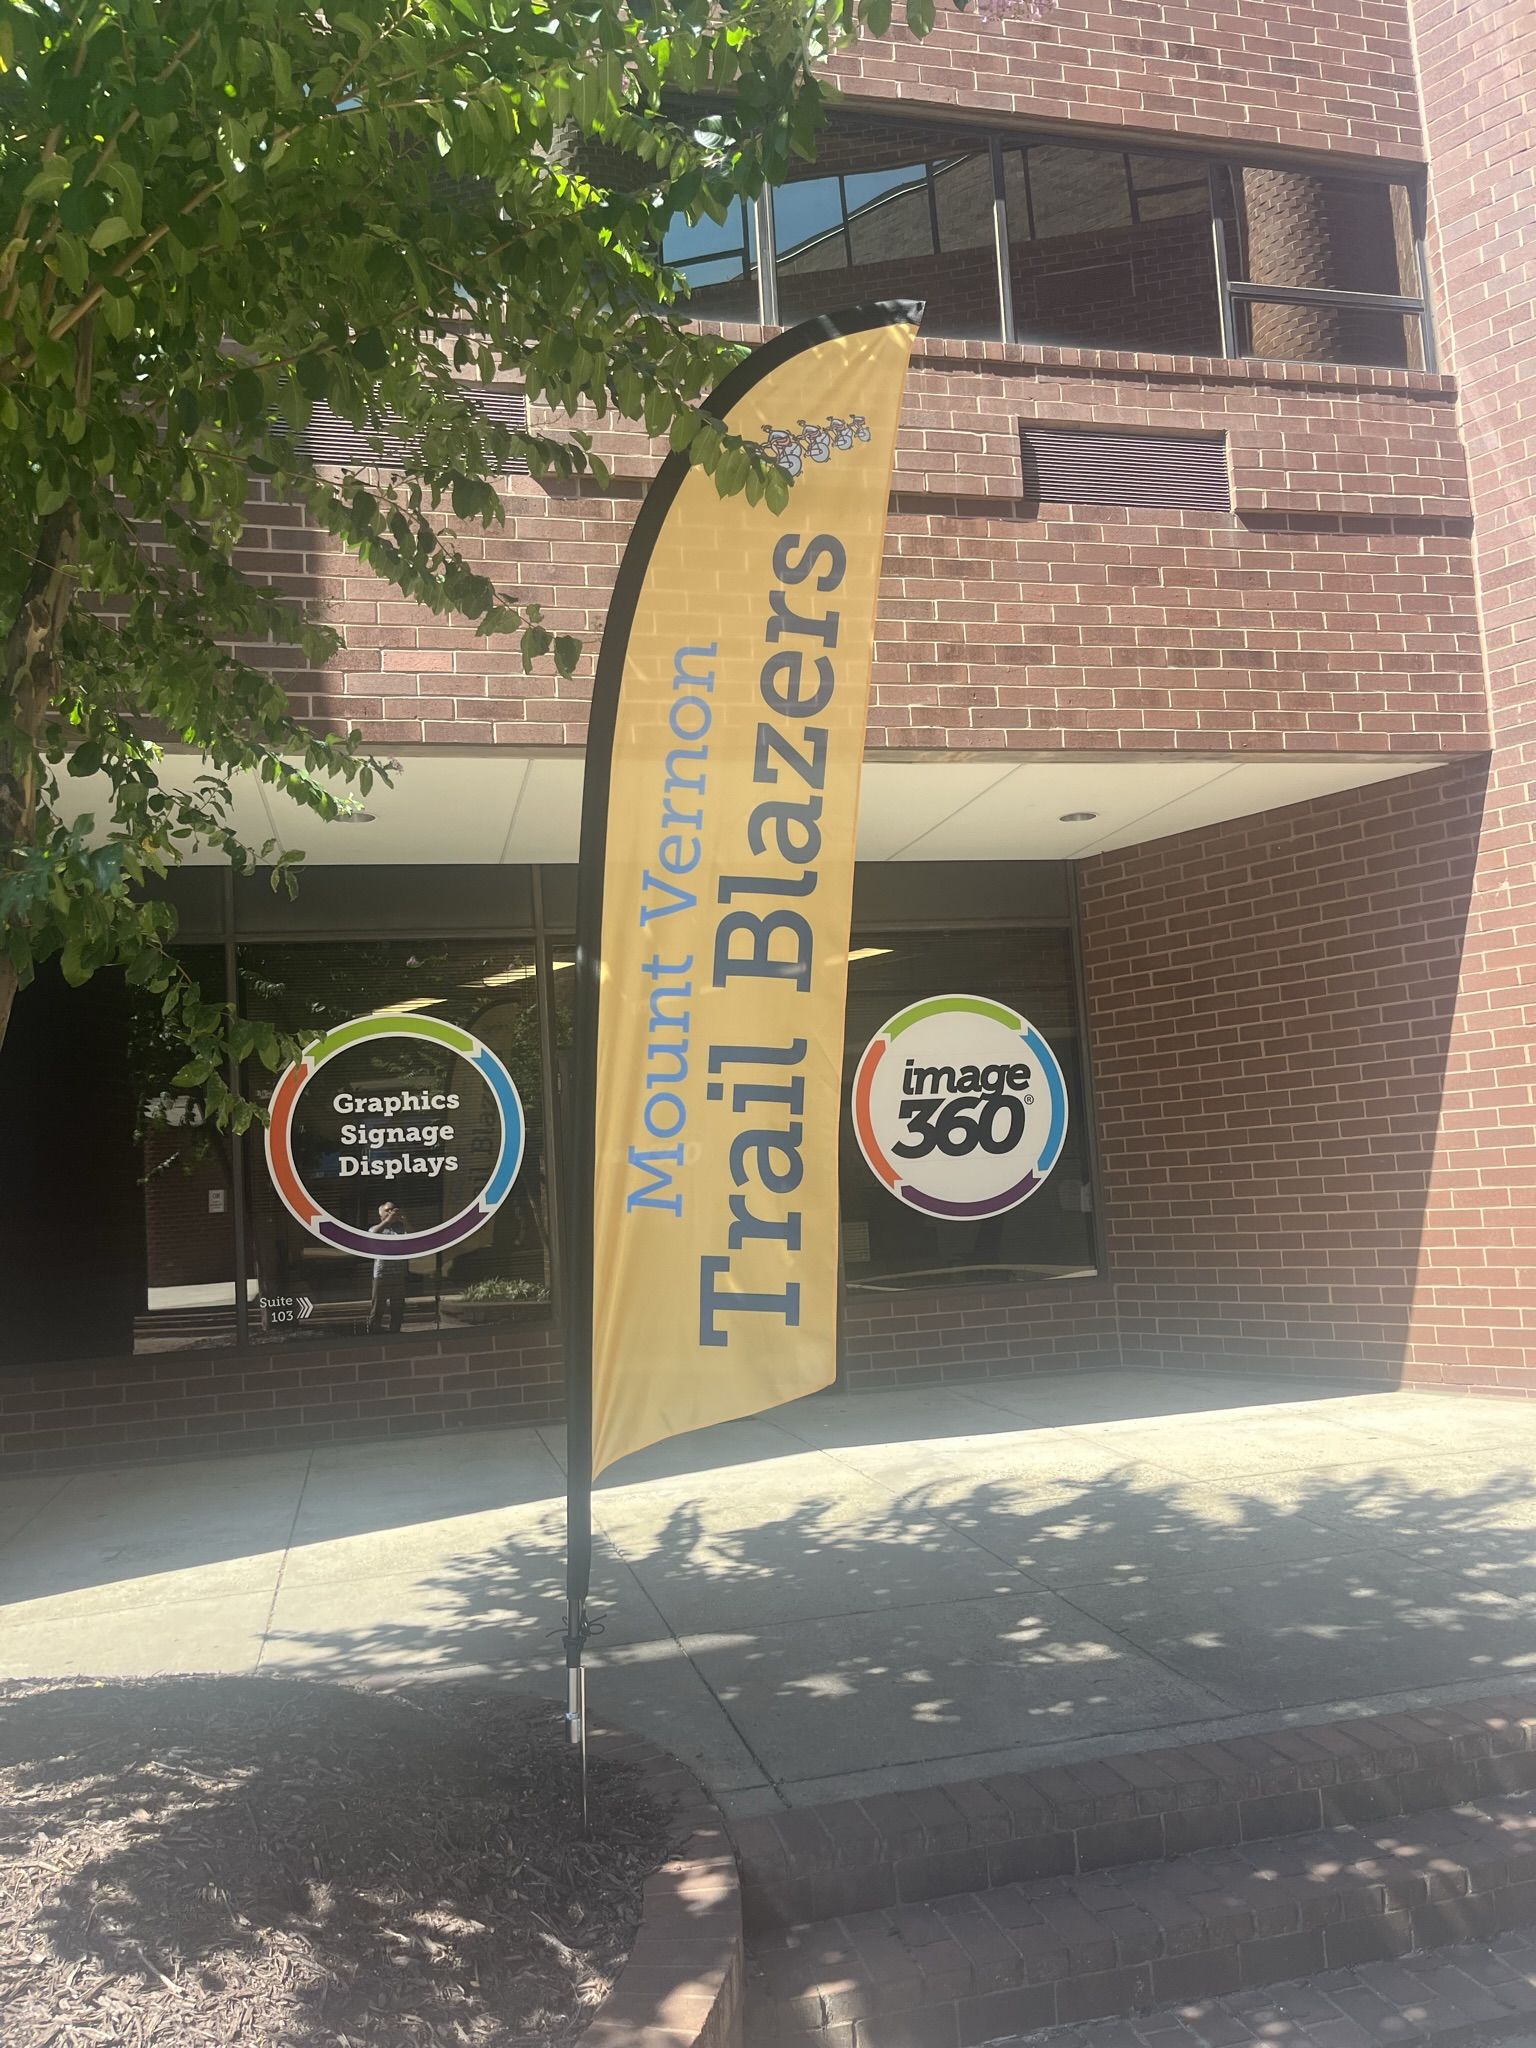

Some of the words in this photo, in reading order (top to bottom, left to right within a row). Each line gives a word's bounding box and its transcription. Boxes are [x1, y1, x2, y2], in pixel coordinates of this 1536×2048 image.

[711, 533, 847, 993] Blazers
[639, 641, 718, 928] Vernon
[626, 954, 694, 1217] Mount
[902, 1058, 1031, 1095] image
[333, 1090, 460, 1117] Graphics
[340, 1124, 455, 1149] Signage
[338, 1153, 459, 1180] Displays
[699, 1038, 807, 1347] Trail
[260, 1296, 293, 1308] Suite
[271, 1310, 294, 1323] 103
